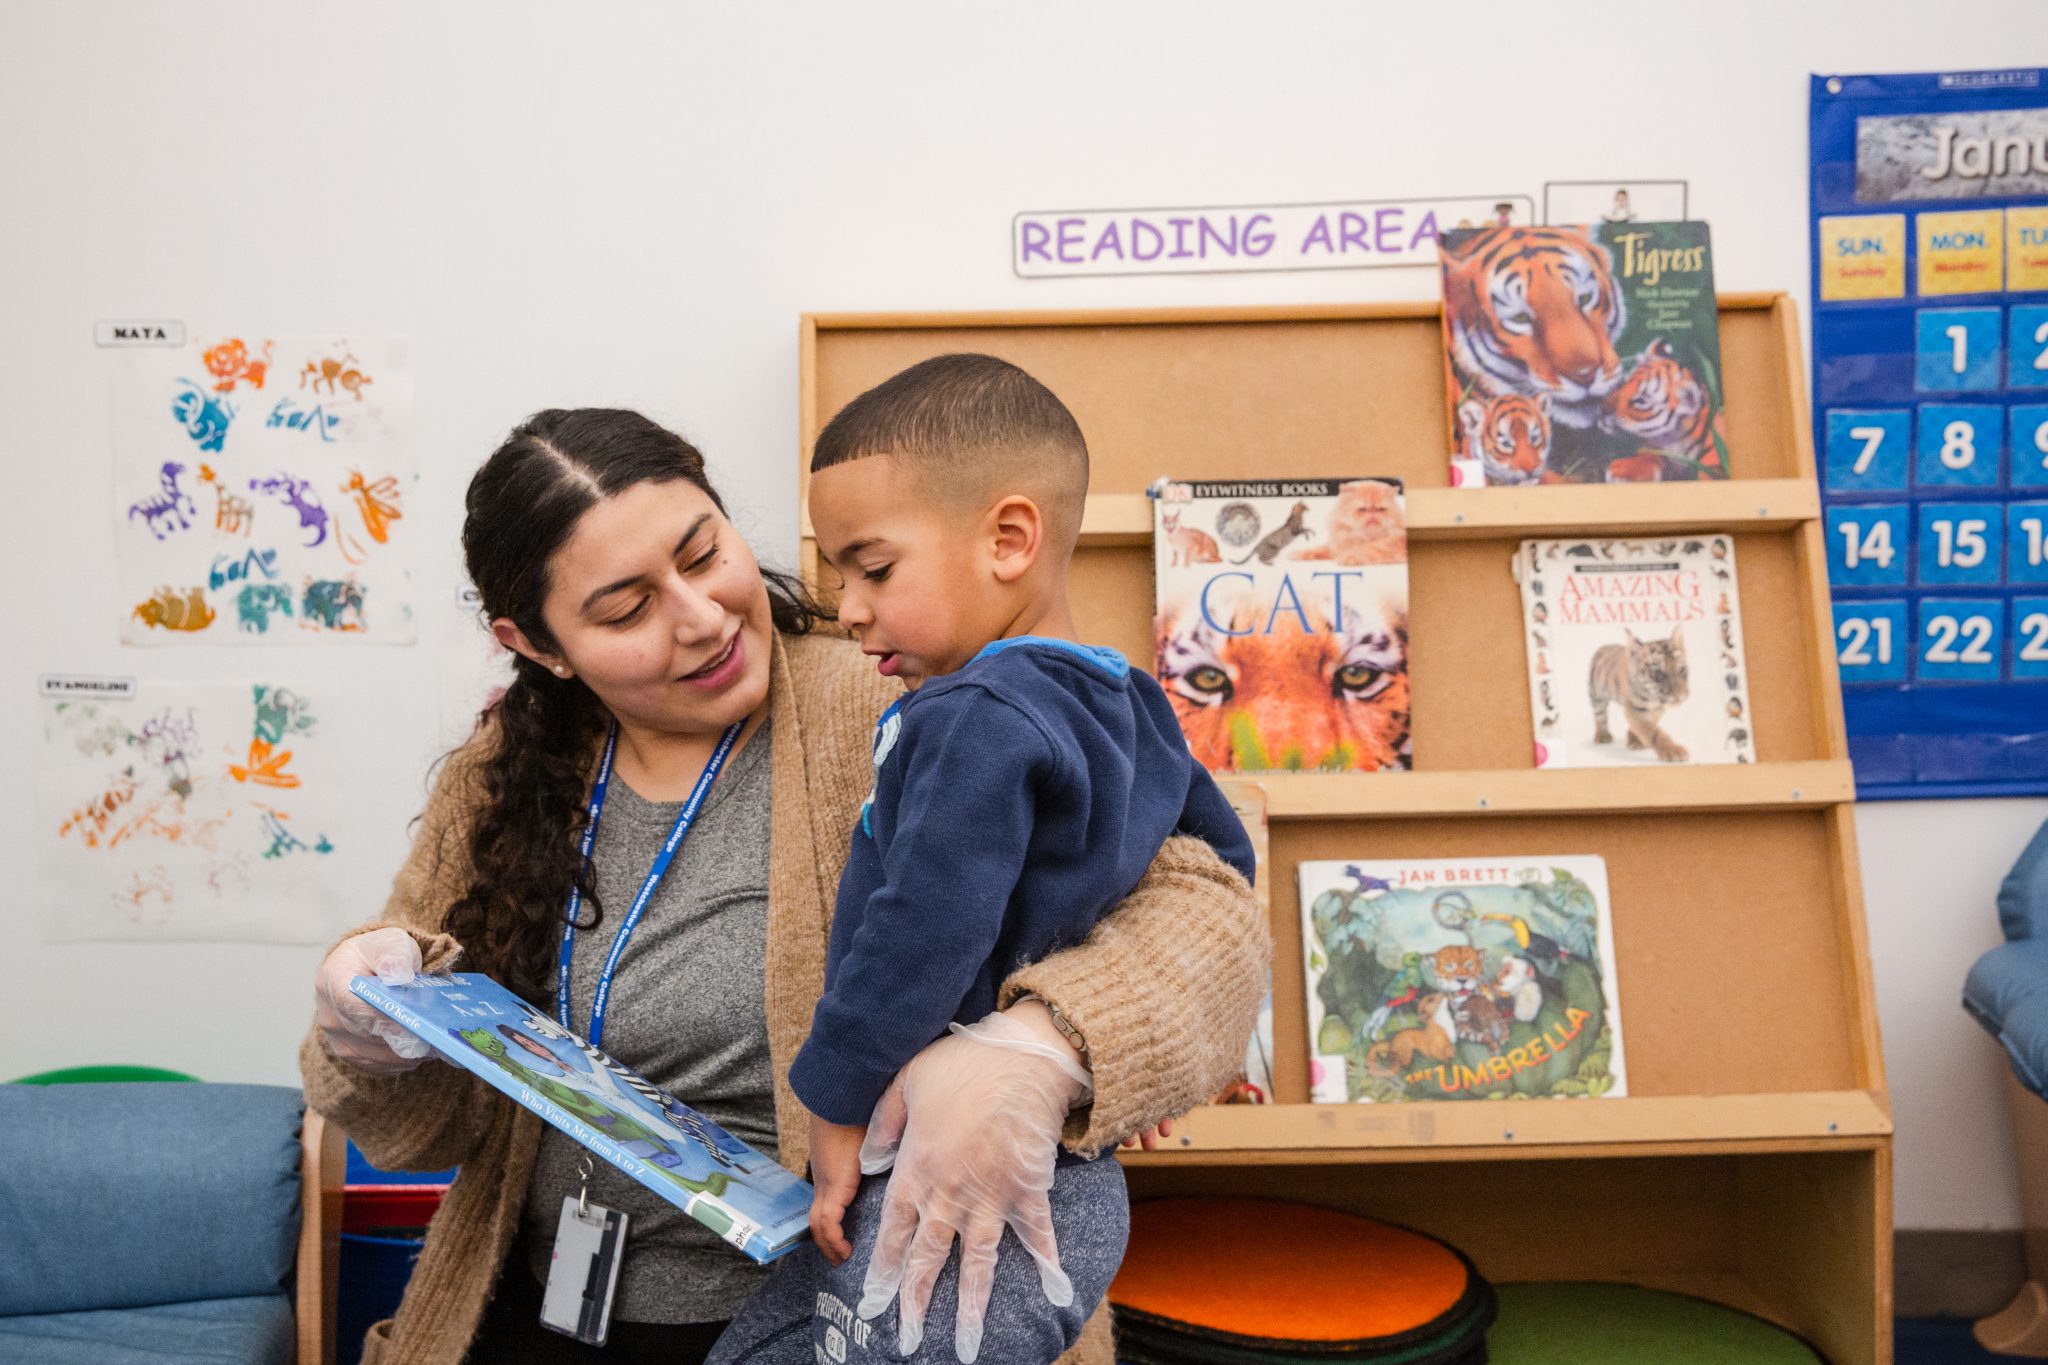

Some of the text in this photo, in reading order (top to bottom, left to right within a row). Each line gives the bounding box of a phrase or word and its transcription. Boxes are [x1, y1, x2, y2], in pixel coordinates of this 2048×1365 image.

[1022, 209, 1440, 264] READING AREA
[1613, 232, 1706, 286] Tigress
[1945, 325, 1968, 374] 1
[1850, 427, 1885, 475] 7
[1940, 421, 1975, 470] 8
[1196, 484, 1279, 497] EYEWITNESS
[1282, 483, 1329, 496] BOOKS
[1838, 521, 1895, 569] 14
[1931, 519, 1988, 568] 15
[2020, 518, 2048, 567] 1
[1200, 572, 1363, 636] CAT
[1559, 571, 1699, 601] AMAZING
[1560, 601, 1706, 624] MAMMALS
[1838, 617, 1892, 665] 21
[1924, 615, 1994, 664] 22
[683, 772, 713, 820] Community
[666, 820, 687, 853] College
[1399, 867, 1509, 885] JAN BRETT
[594, 874, 660, 1018] Westchester Community College
[356, 981, 422, 1030] Roos/O'Keefe
[478, 1001, 504, 1014] Z
[1435, 1007, 1592, 1092] UMBRELLA
[520, 1089, 647, 1177] Who Visits Me from A to Z
[854, 1318, 872, 1348] OF
